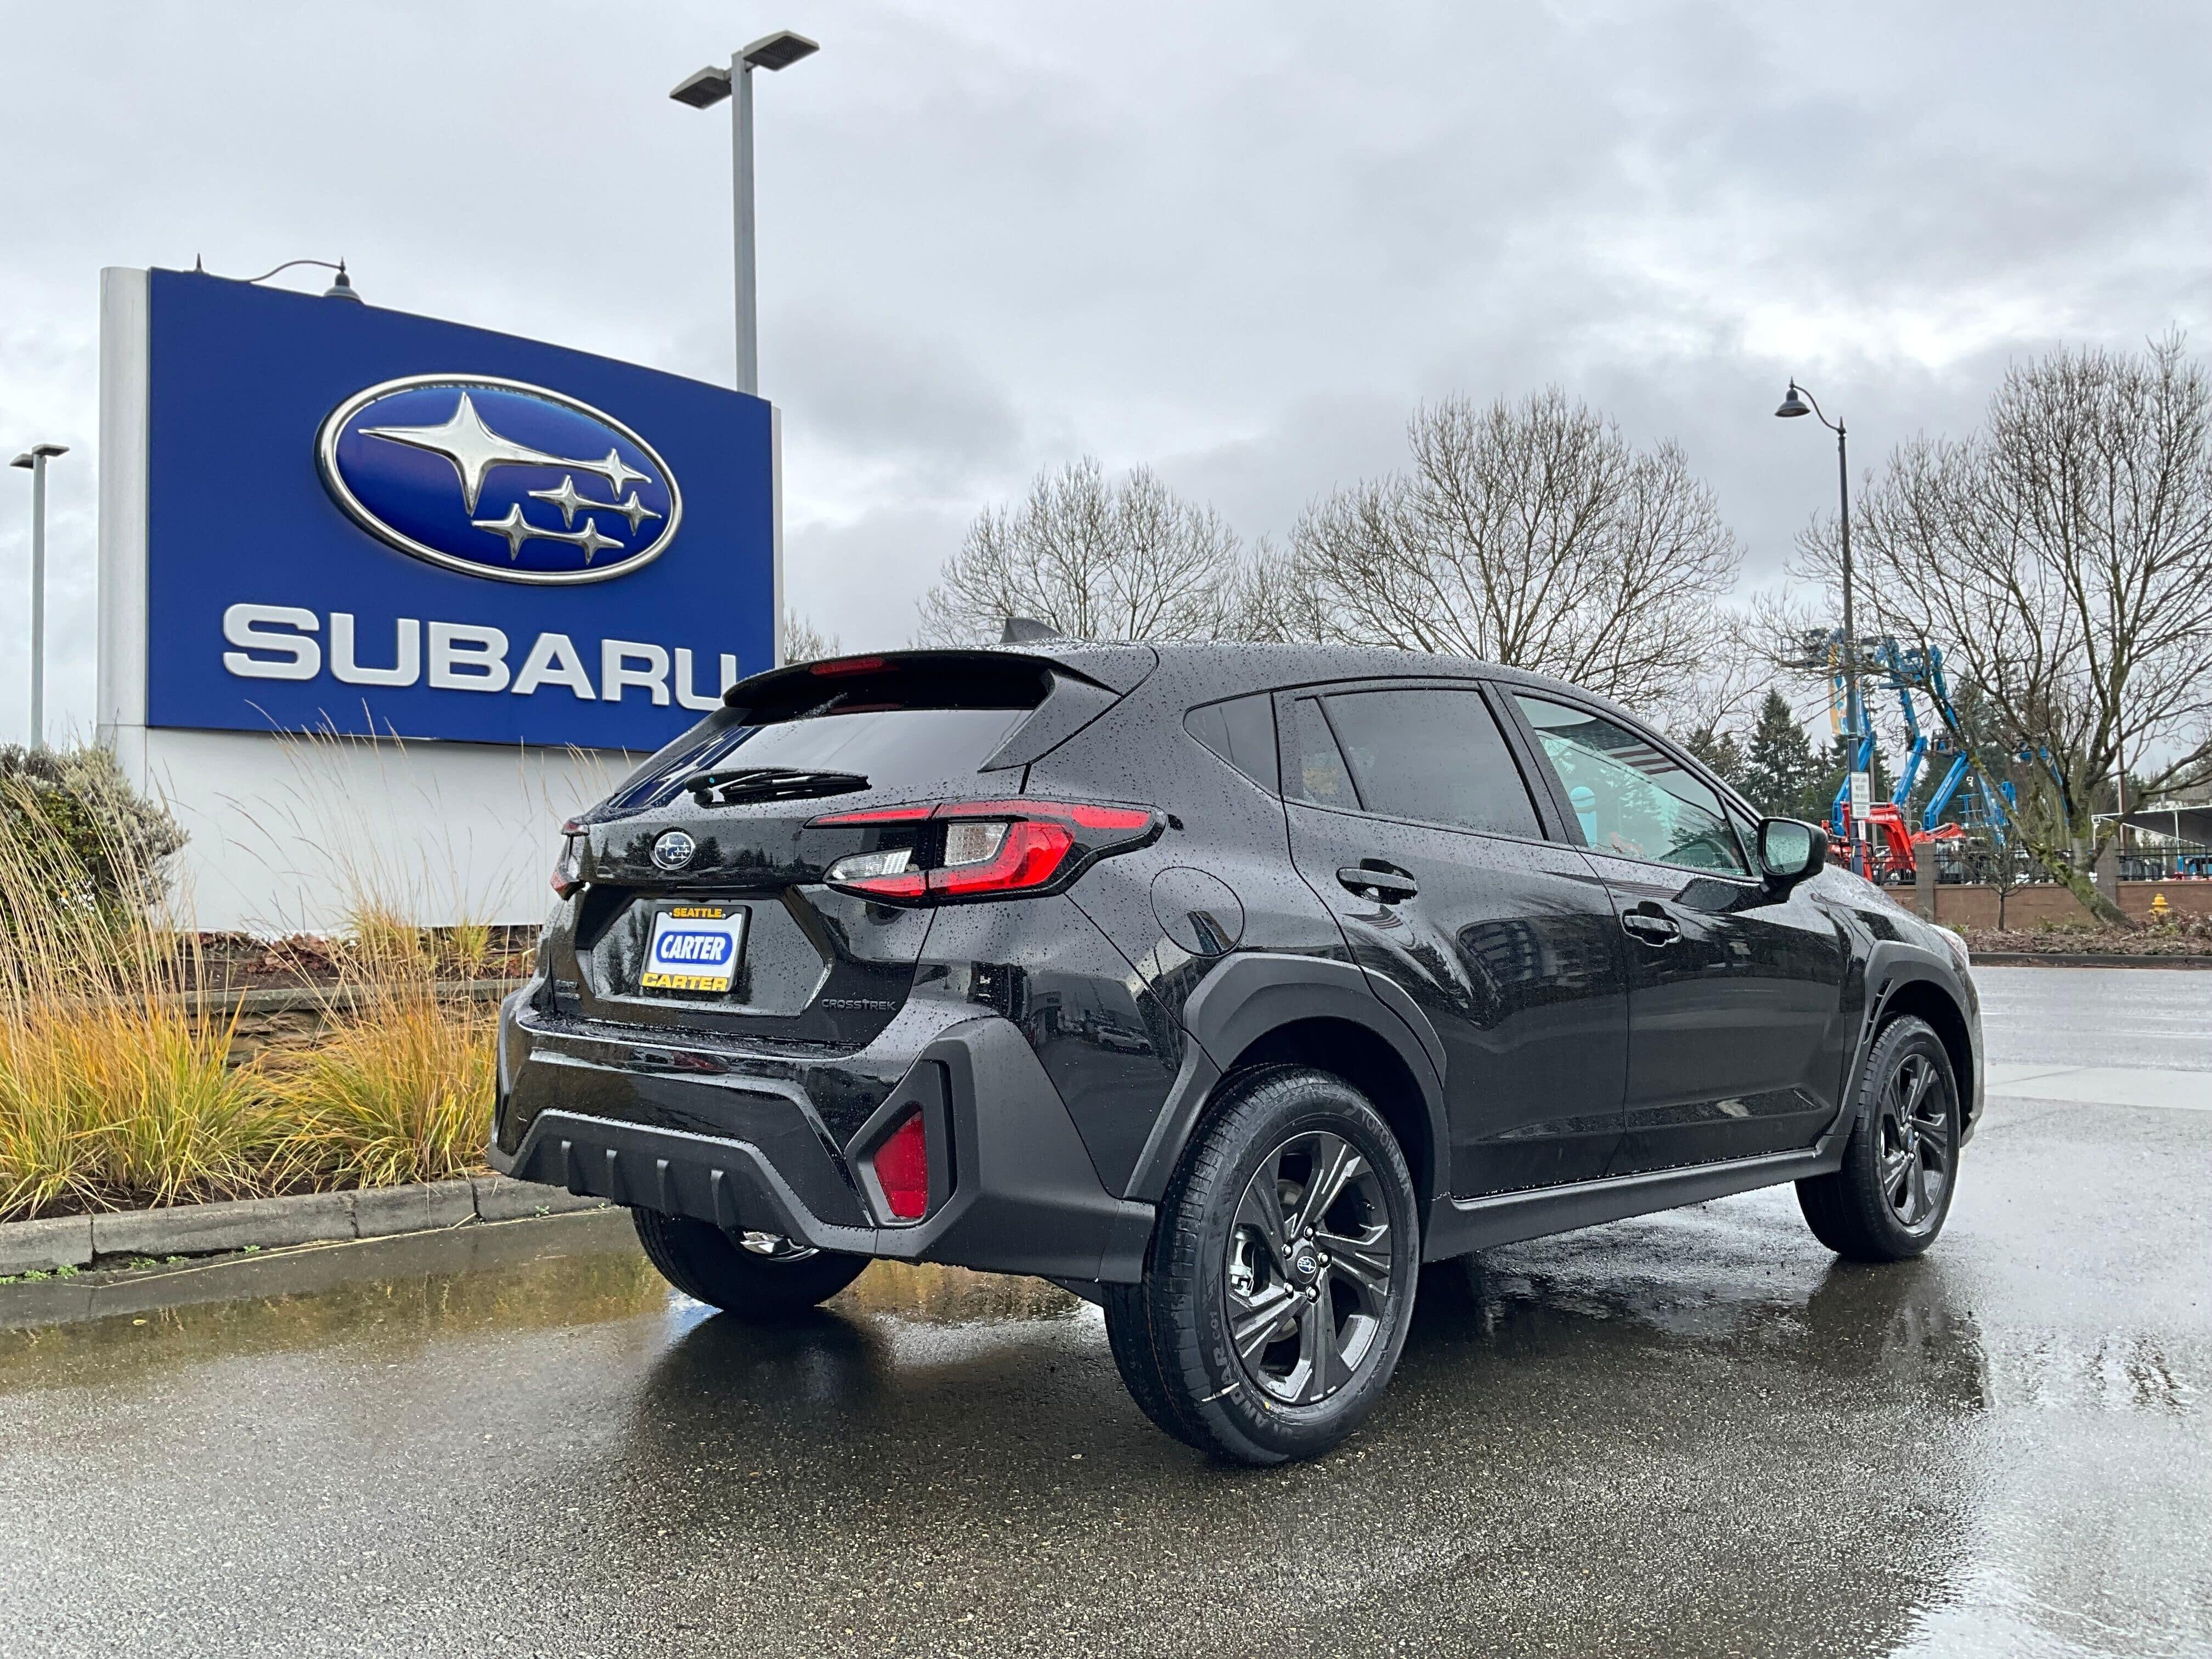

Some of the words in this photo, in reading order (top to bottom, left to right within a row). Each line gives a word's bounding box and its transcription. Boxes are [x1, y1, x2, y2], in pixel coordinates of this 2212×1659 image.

[223, 603, 736, 712] SUBARU
[673, 908, 722, 918] SEATTLE
[661, 935, 726, 961] CARTER
[642, 973, 727, 991] CARTER
[822, 998, 896, 1011] CROSSTREK
